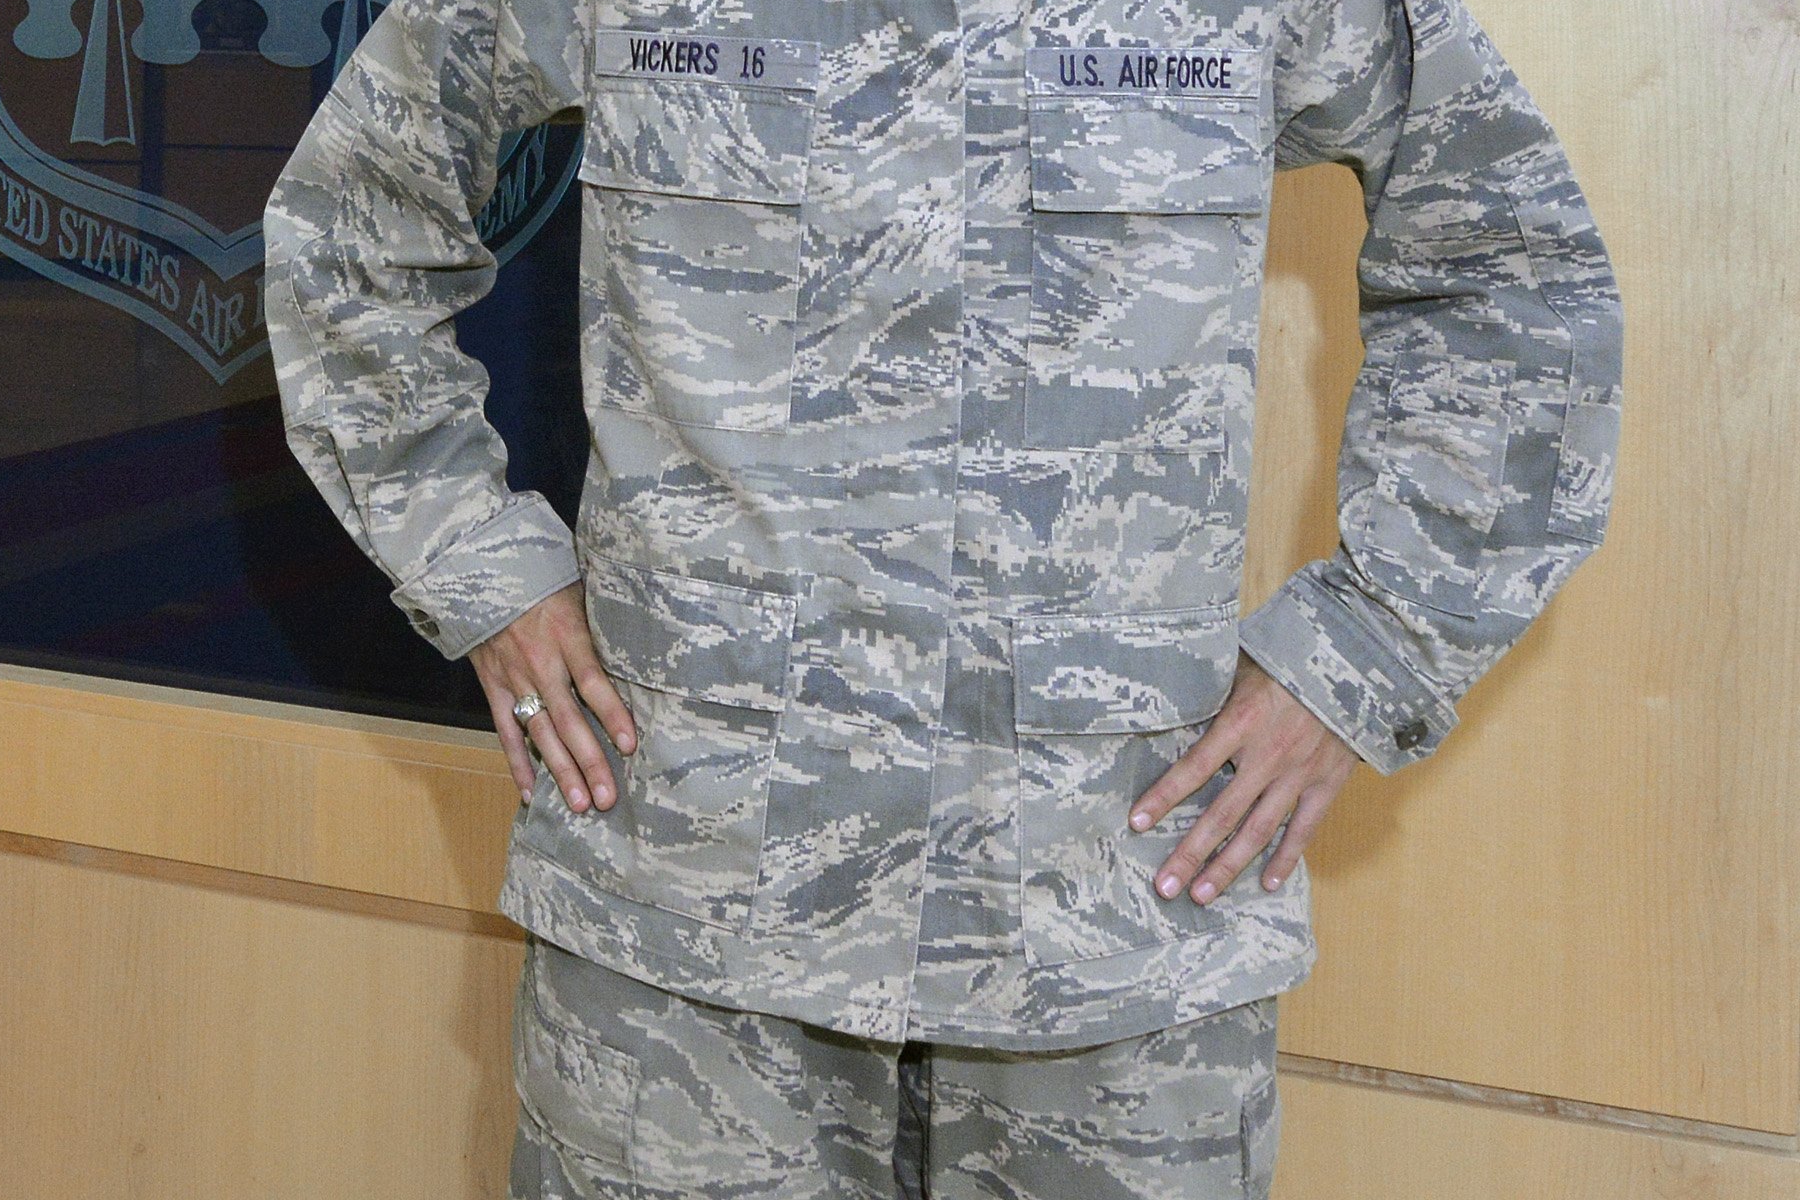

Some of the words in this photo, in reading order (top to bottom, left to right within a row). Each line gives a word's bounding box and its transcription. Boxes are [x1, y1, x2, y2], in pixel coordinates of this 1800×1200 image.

[630, 38, 720, 75] VICKERS
[739, 45, 766, 78] 16
[1059, 54, 1104, 87] U.S.
[1118, 54, 1157, 88] AIR
[1166, 56, 1232, 89] FORCE
[58, 206, 180, 311] STATES
[187, 279, 246, 356] AIR
